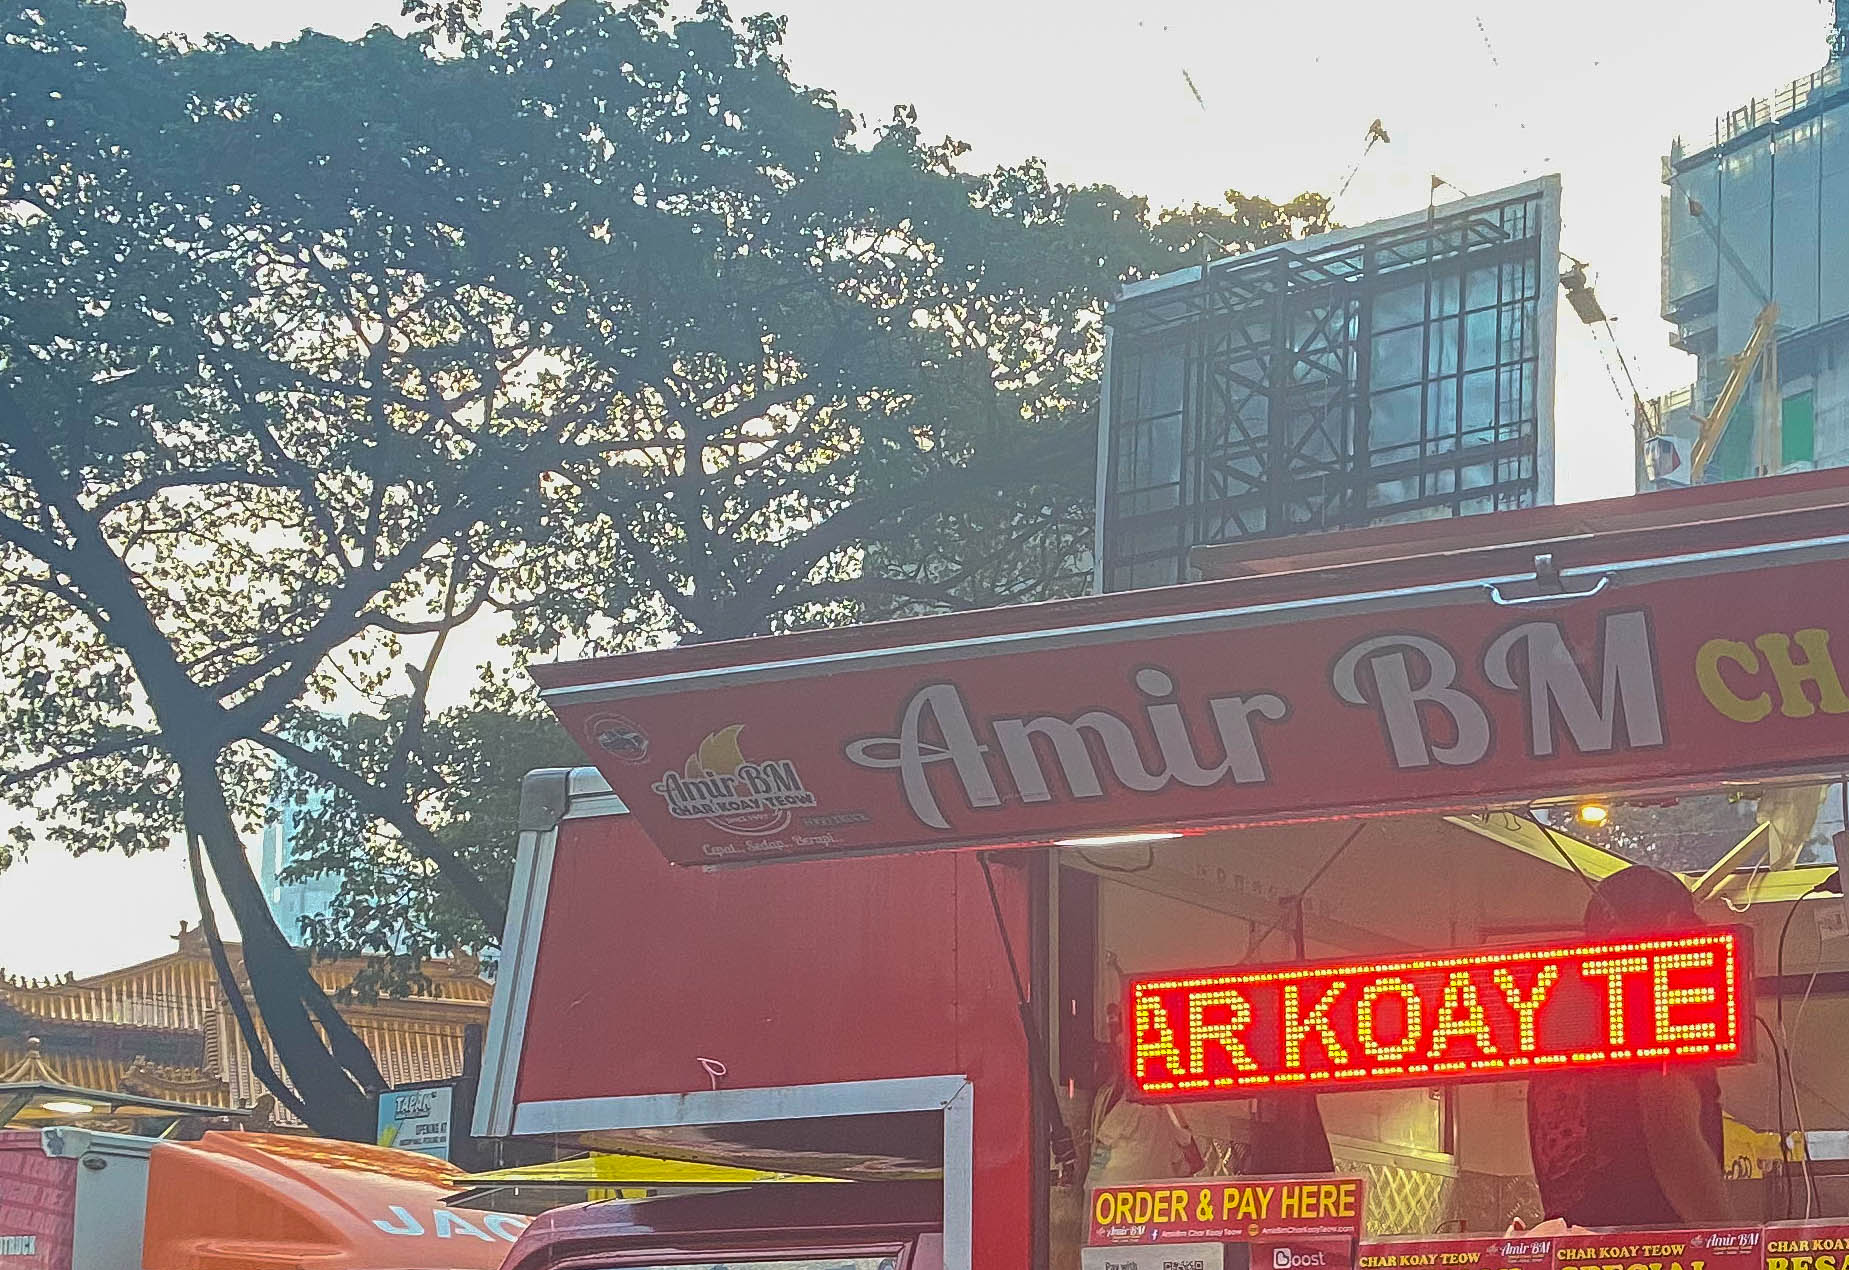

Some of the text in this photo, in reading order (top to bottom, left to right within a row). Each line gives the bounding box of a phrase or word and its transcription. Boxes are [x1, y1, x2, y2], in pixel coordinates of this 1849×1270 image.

[845, 668, 1287, 829] Amir
[1332, 610, 1665, 769] BM
[655, 761, 802, 806] Amir BM
[718, 798, 762, 813] KOAY
[765, 793, 814, 808] TEOW
[1136, 951, 1715, 1077] AR KOAY TE
[1095, 1183, 1357, 1226] ORDER & PAY HERE
[371, 1205, 528, 1243] JAC
[1359, 1252, 1481, 1268] CHAR KOAY TEOW
[1556, 1248, 1597, 1260] CHAR
[1599, 1246, 1640, 1258] KOAY
[1642, 1244, 1686, 1256] TEOW
[1767, 1240, 1812, 1253] CHAR
